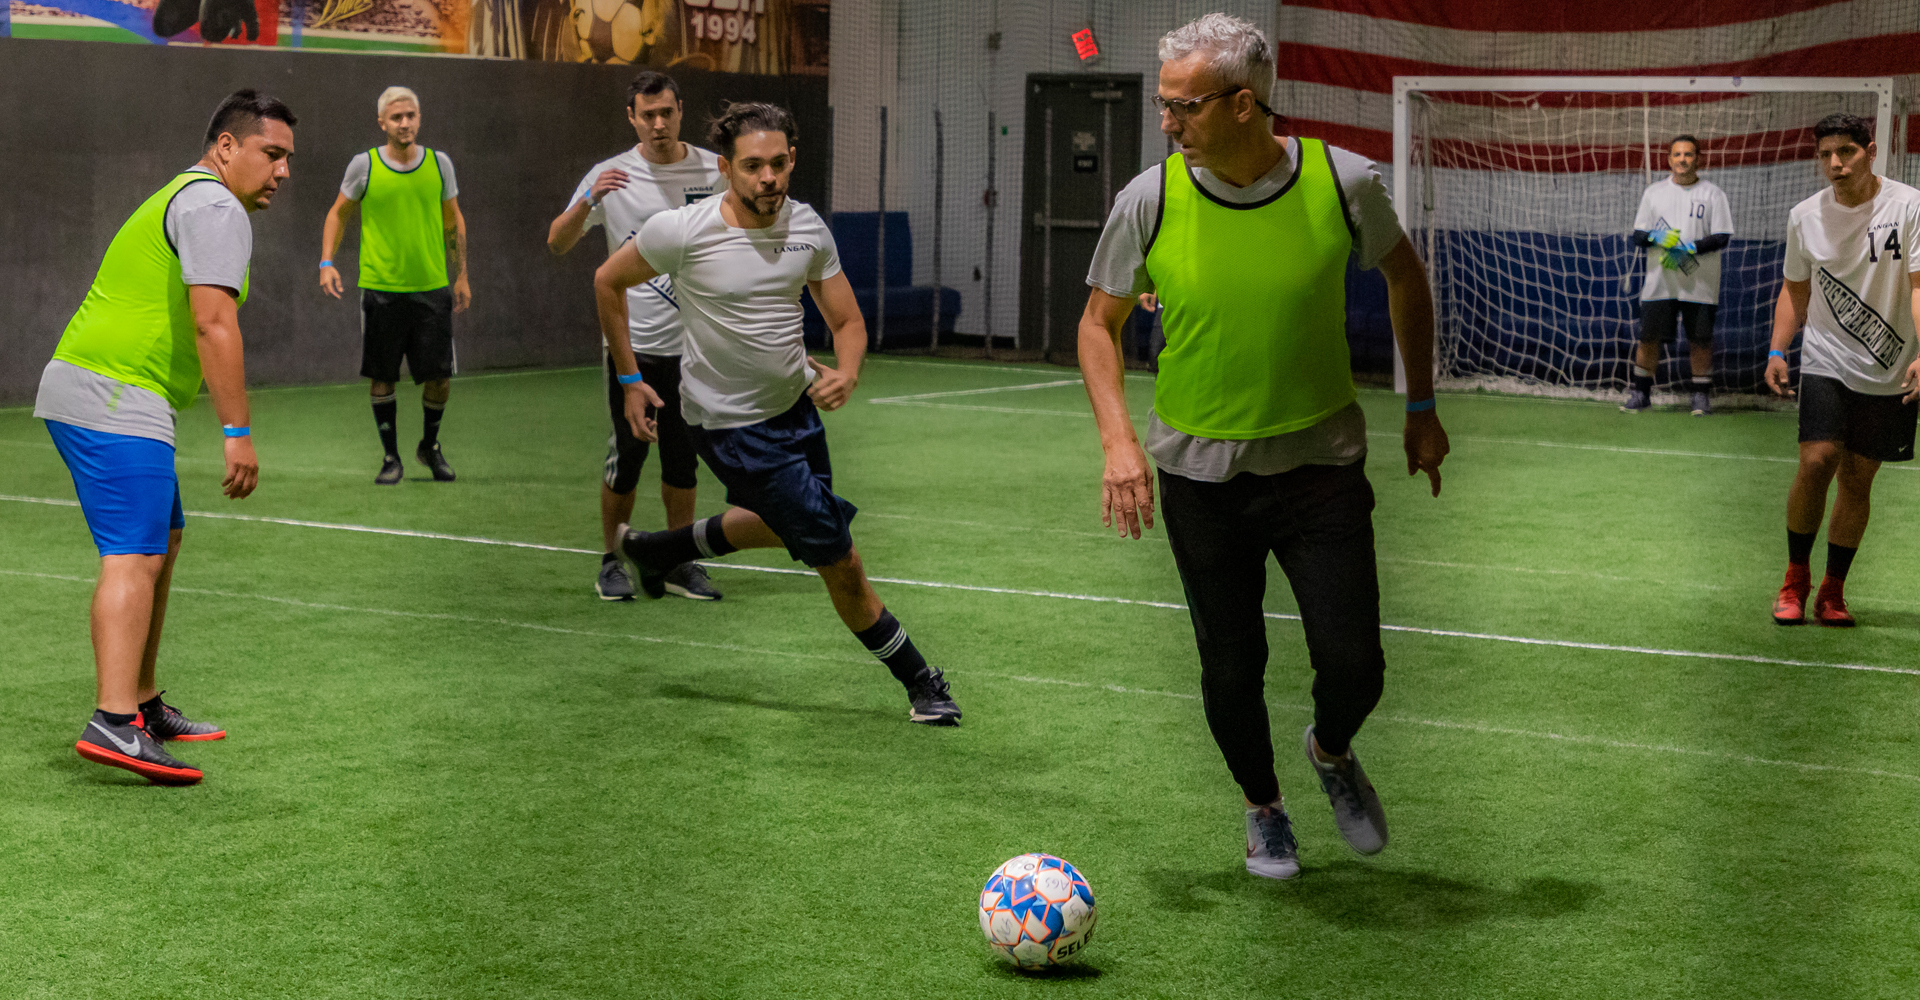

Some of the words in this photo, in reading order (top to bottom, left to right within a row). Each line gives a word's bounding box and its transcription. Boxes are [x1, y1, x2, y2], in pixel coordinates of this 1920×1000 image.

[691, 13, 756, 43] 1994
[1071, 28, 1098, 60] EXIT
[1689, 202, 1705, 219] 10
[1867, 228, 1902, 262] 14
